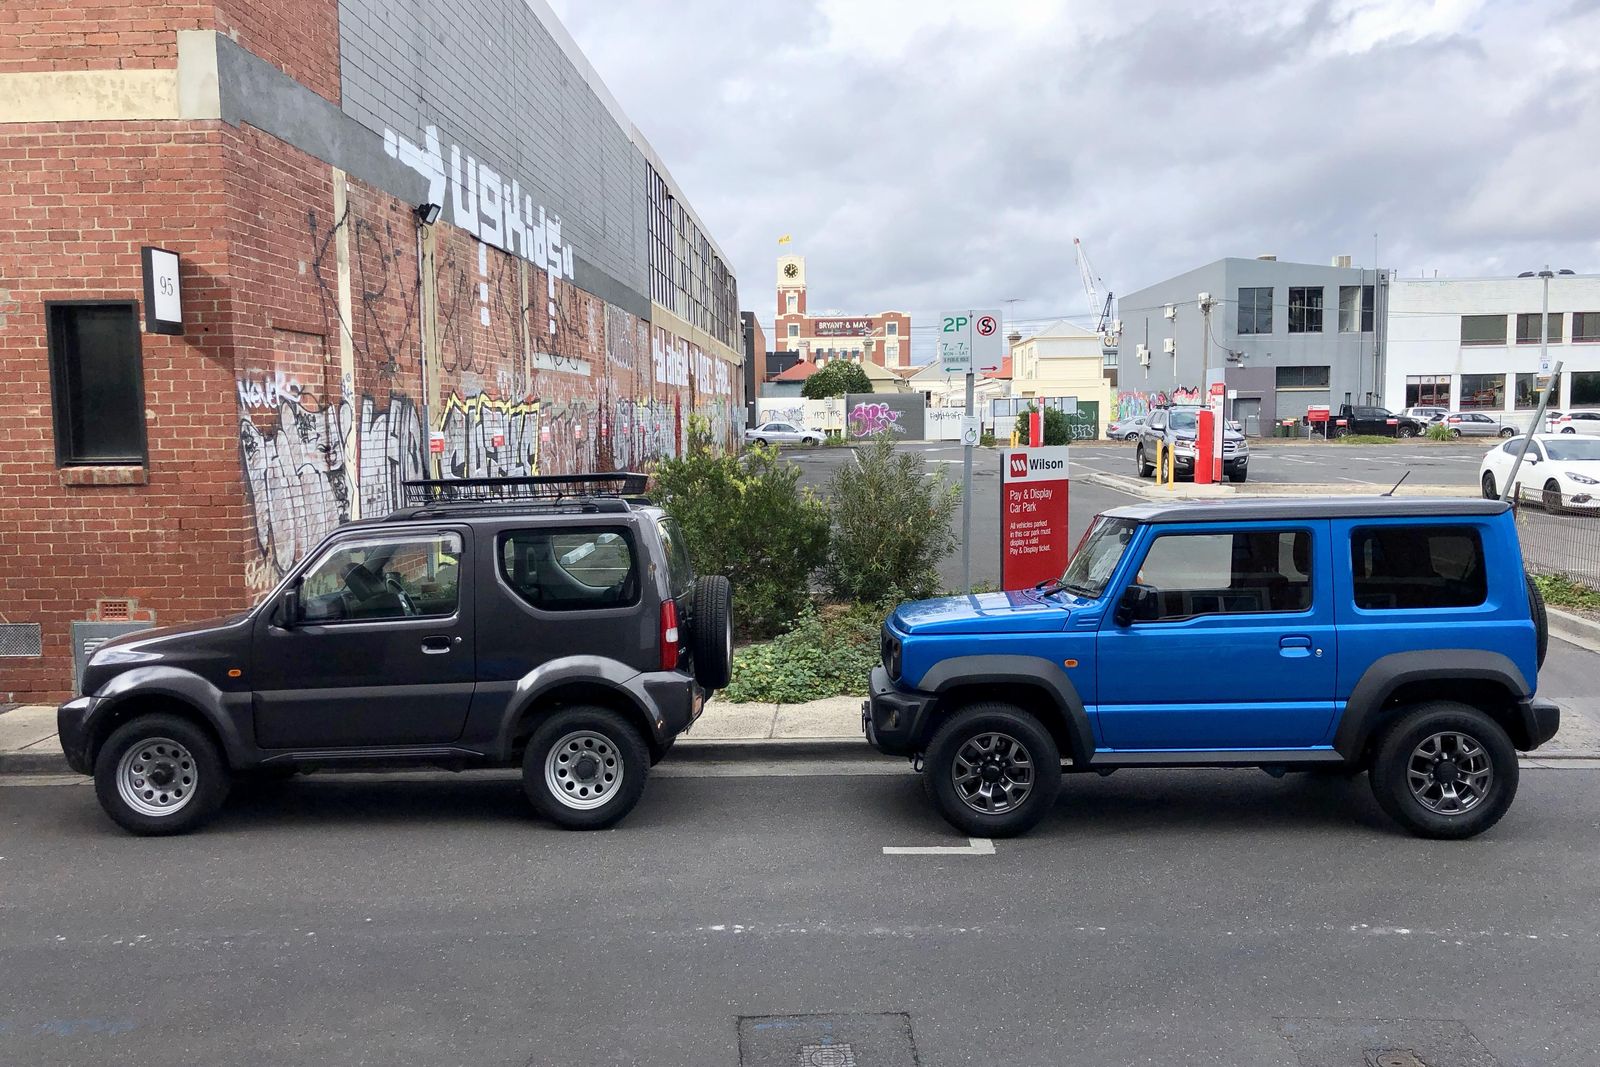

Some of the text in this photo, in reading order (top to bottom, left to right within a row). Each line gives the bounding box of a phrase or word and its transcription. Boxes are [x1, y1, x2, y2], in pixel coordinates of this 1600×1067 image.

[160, 276, 173, 296] 95
[819, 321, 867, 329] BRYANT & MAY
[943, 317, 968, 332] 2P
[1029, 459, 1063, 470] Wilson
[1010, 488, 1052, 502] Pay & Display
[1010, 502, 1036, 513] Car Park
[1033, 520, 1048, 528] parked
[1031, 529, 1040, 537] park
[1010, 539, 1025, 547] display
[1029, 537, 1039, 545] valid
[1010, 547, 1019, 555] Pay
[1023, 546, 1039, 554] Display
[1039, 544, 1051, 552] ticket.
